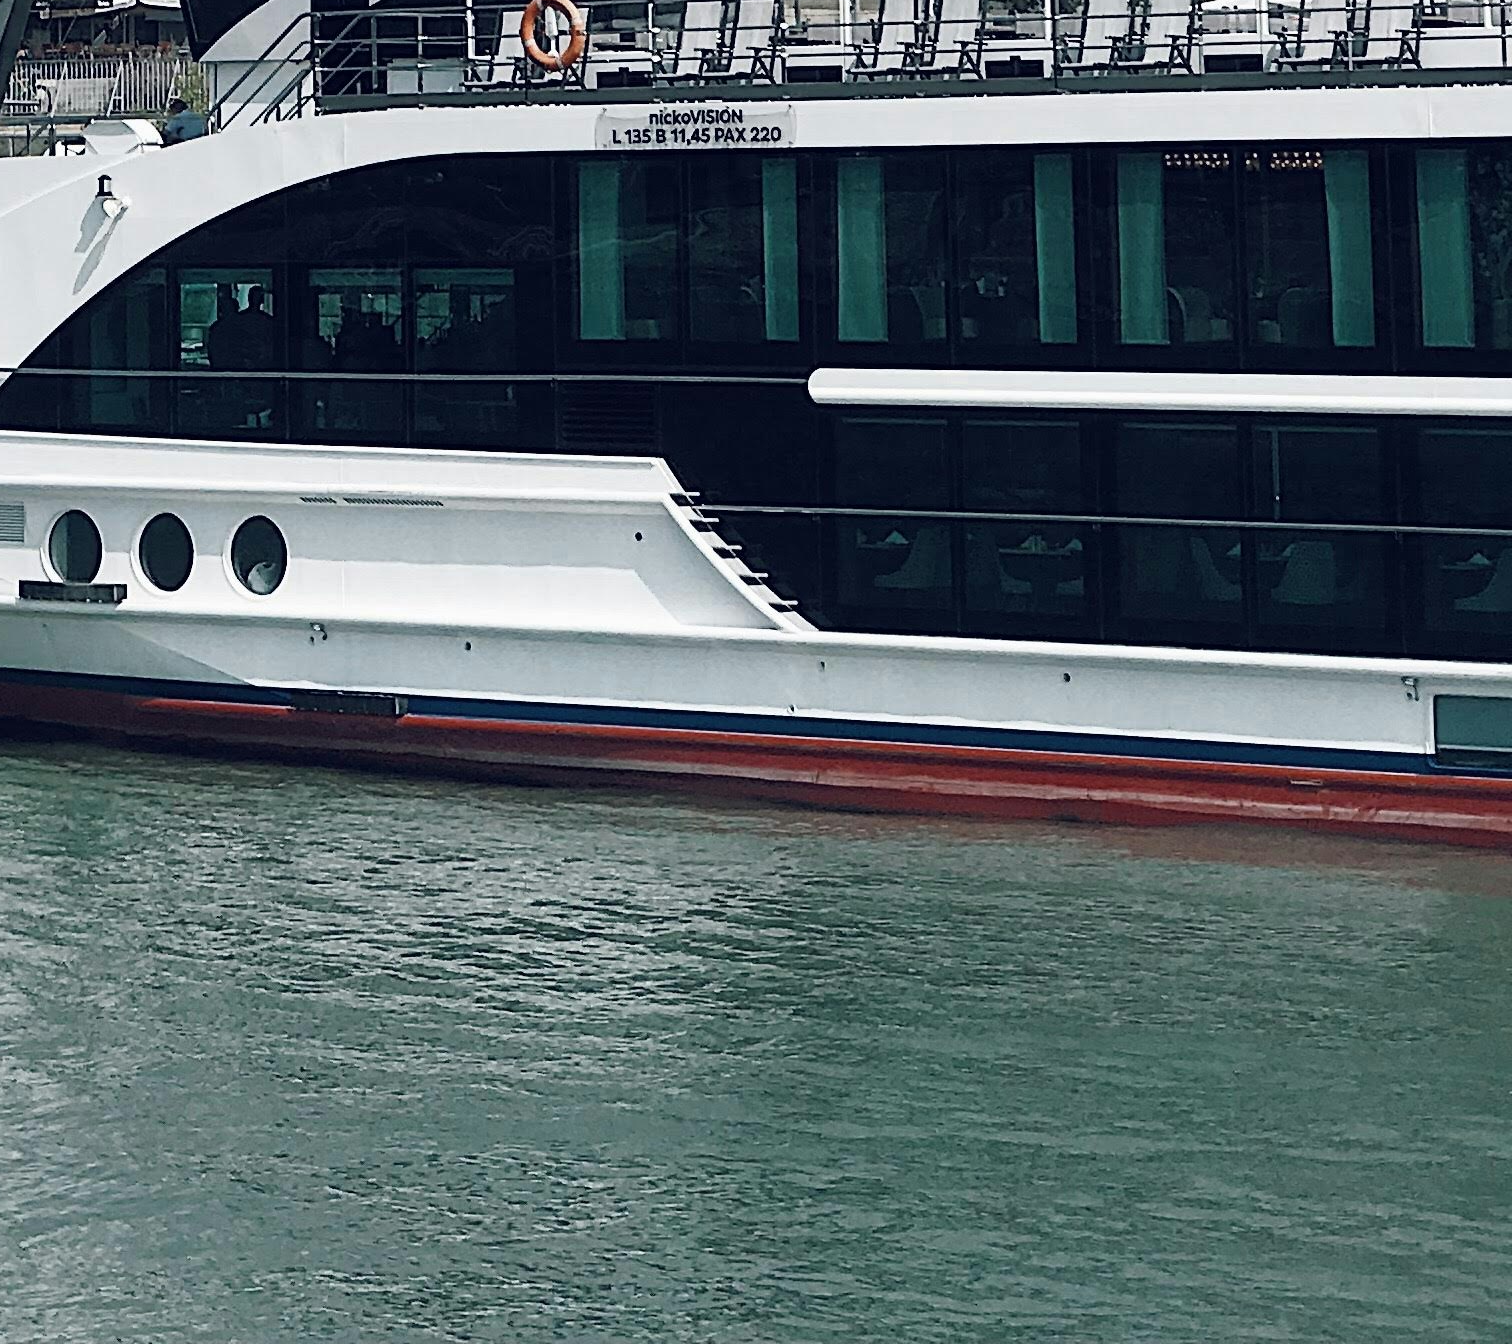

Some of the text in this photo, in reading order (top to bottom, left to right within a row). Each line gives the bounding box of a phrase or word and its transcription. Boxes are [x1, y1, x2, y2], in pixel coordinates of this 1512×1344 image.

[649, 108, 744, 125] nickoVISION
[612, 126, 782, 146] L 135 B 11,45 PAX 220
